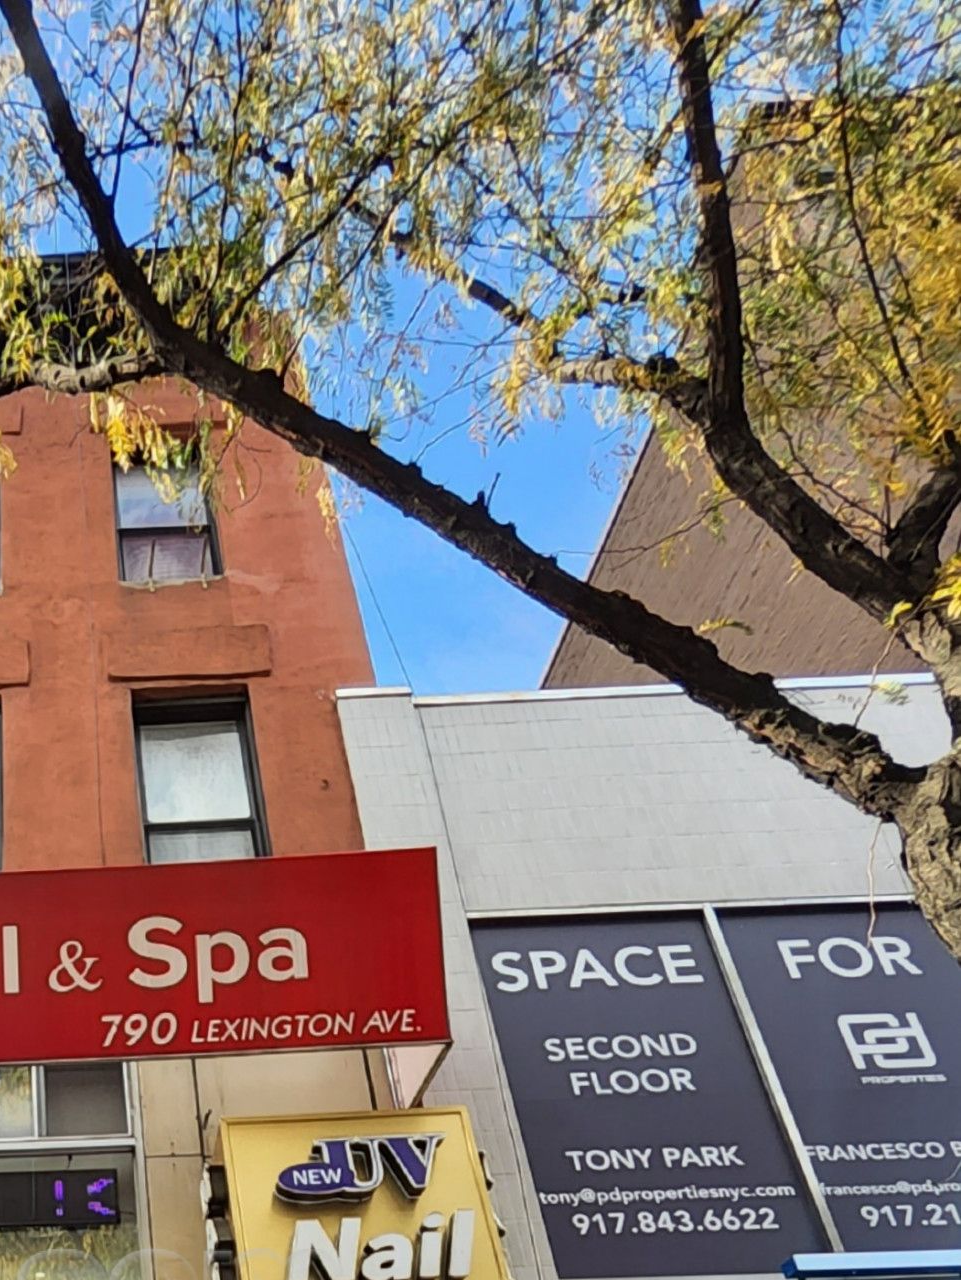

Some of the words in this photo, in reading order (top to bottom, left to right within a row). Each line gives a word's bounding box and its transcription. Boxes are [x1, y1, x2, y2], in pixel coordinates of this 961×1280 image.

[48, 940, 102, 992] &
[127, 915, 309, 1004] Spa
[491, 944, 705, 993] SPACE
[776, 936, 923, 980] FOR
[100, 1012, 178, 1048] 790
[190, 1011, 356, 1044] LEXINGTON
[362, 1008, 422, 1035] AVE.
[543, 1032, 698, 1062] SECOND
[569, 1067, 697, 1096] FLOOR
[311, 1132, 446, 1199] UV
[564, 1148, 652, 1173] TONY
[663, 1144, 745, 1169] PARK
[805, 1141, 945, 1162] FRANCESCO
[292, 1168, 342, 1188] NEW
[539, 1182, 796, 1206] tony@pdpropertiesnyc.com
[571, 1206, 780, 1235] 917.843.6622
